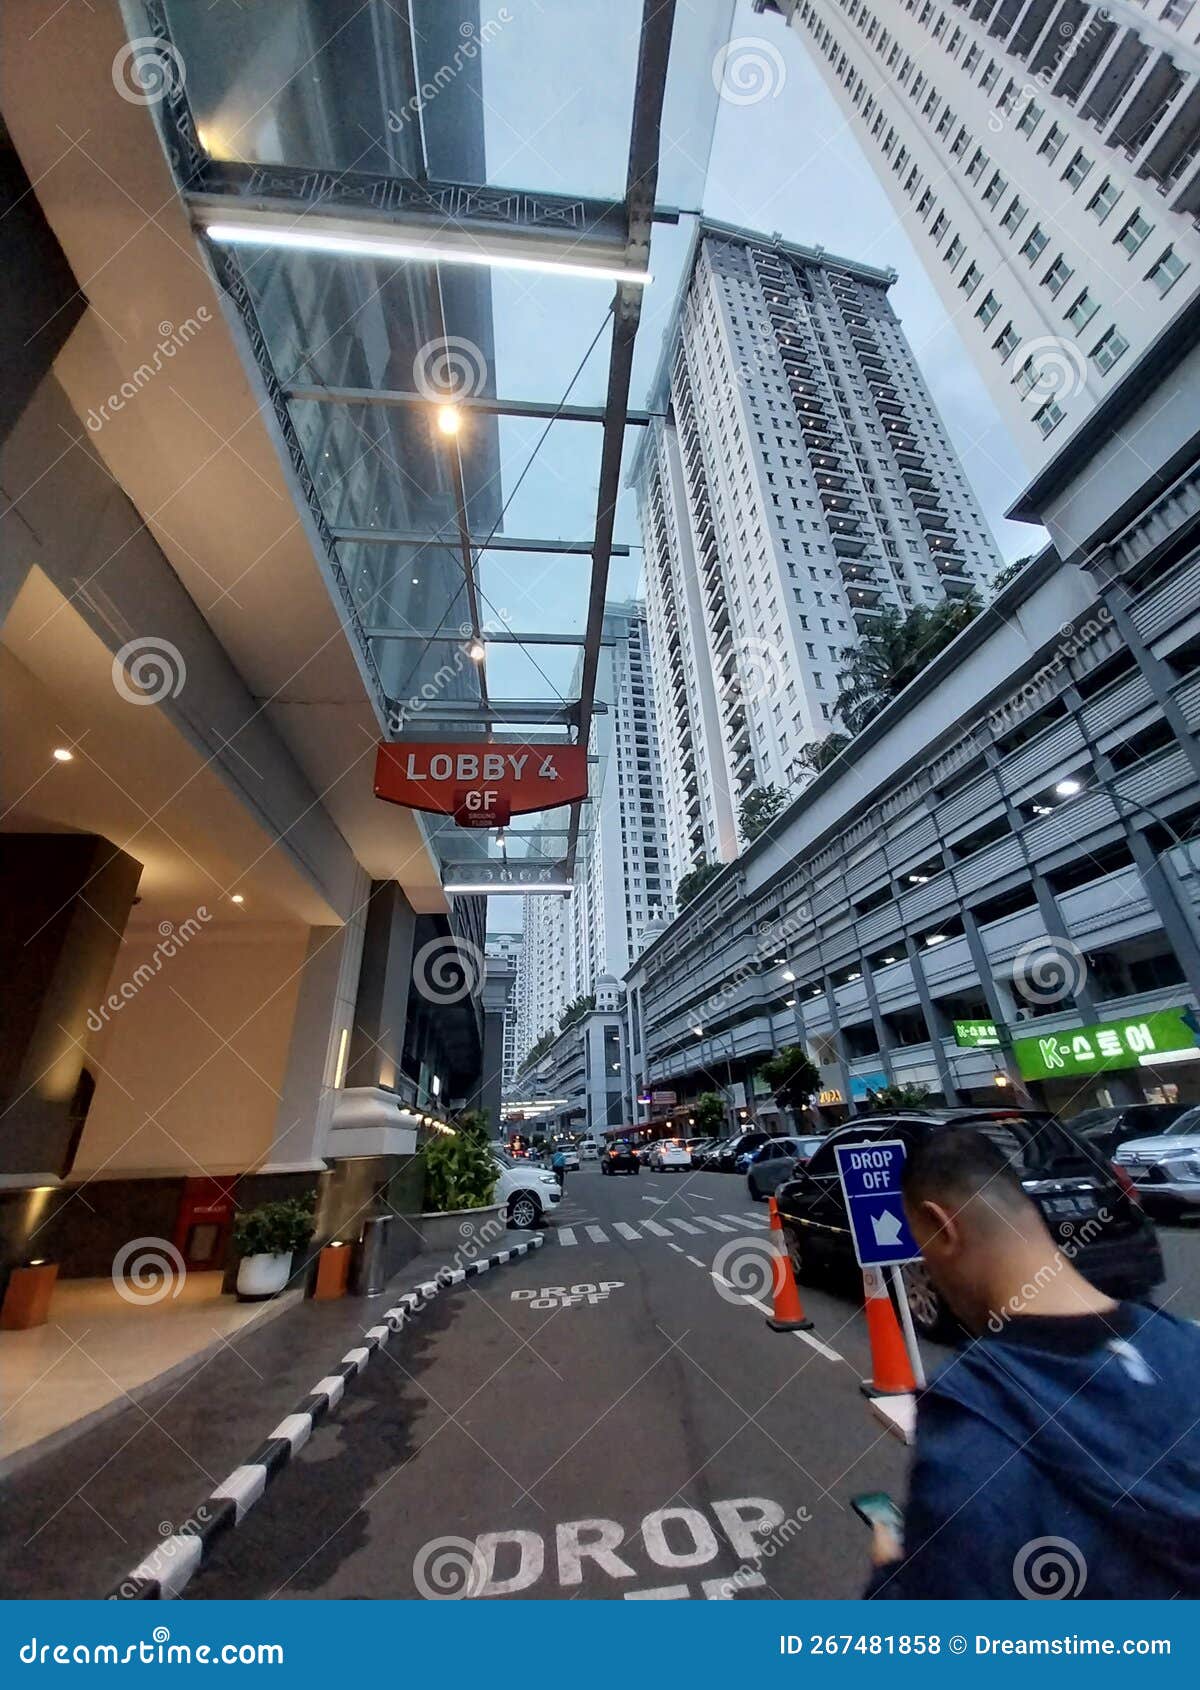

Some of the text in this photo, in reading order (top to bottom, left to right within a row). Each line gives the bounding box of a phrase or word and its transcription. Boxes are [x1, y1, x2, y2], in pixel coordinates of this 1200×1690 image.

[406, 753, 558, 781] LOBBY 4
[465, 790, 499, 811] GF
[1038, 1023, 1156, 1069] K-스토어
[851, 1150, 893, 1170] DROP
[863, 1171, 891, 1189] OFF
[511, 1281, 625, 1301] DROP
[530, 1292, 610, 1309] OFF
[466, 1496, 786, 1599] DROP
